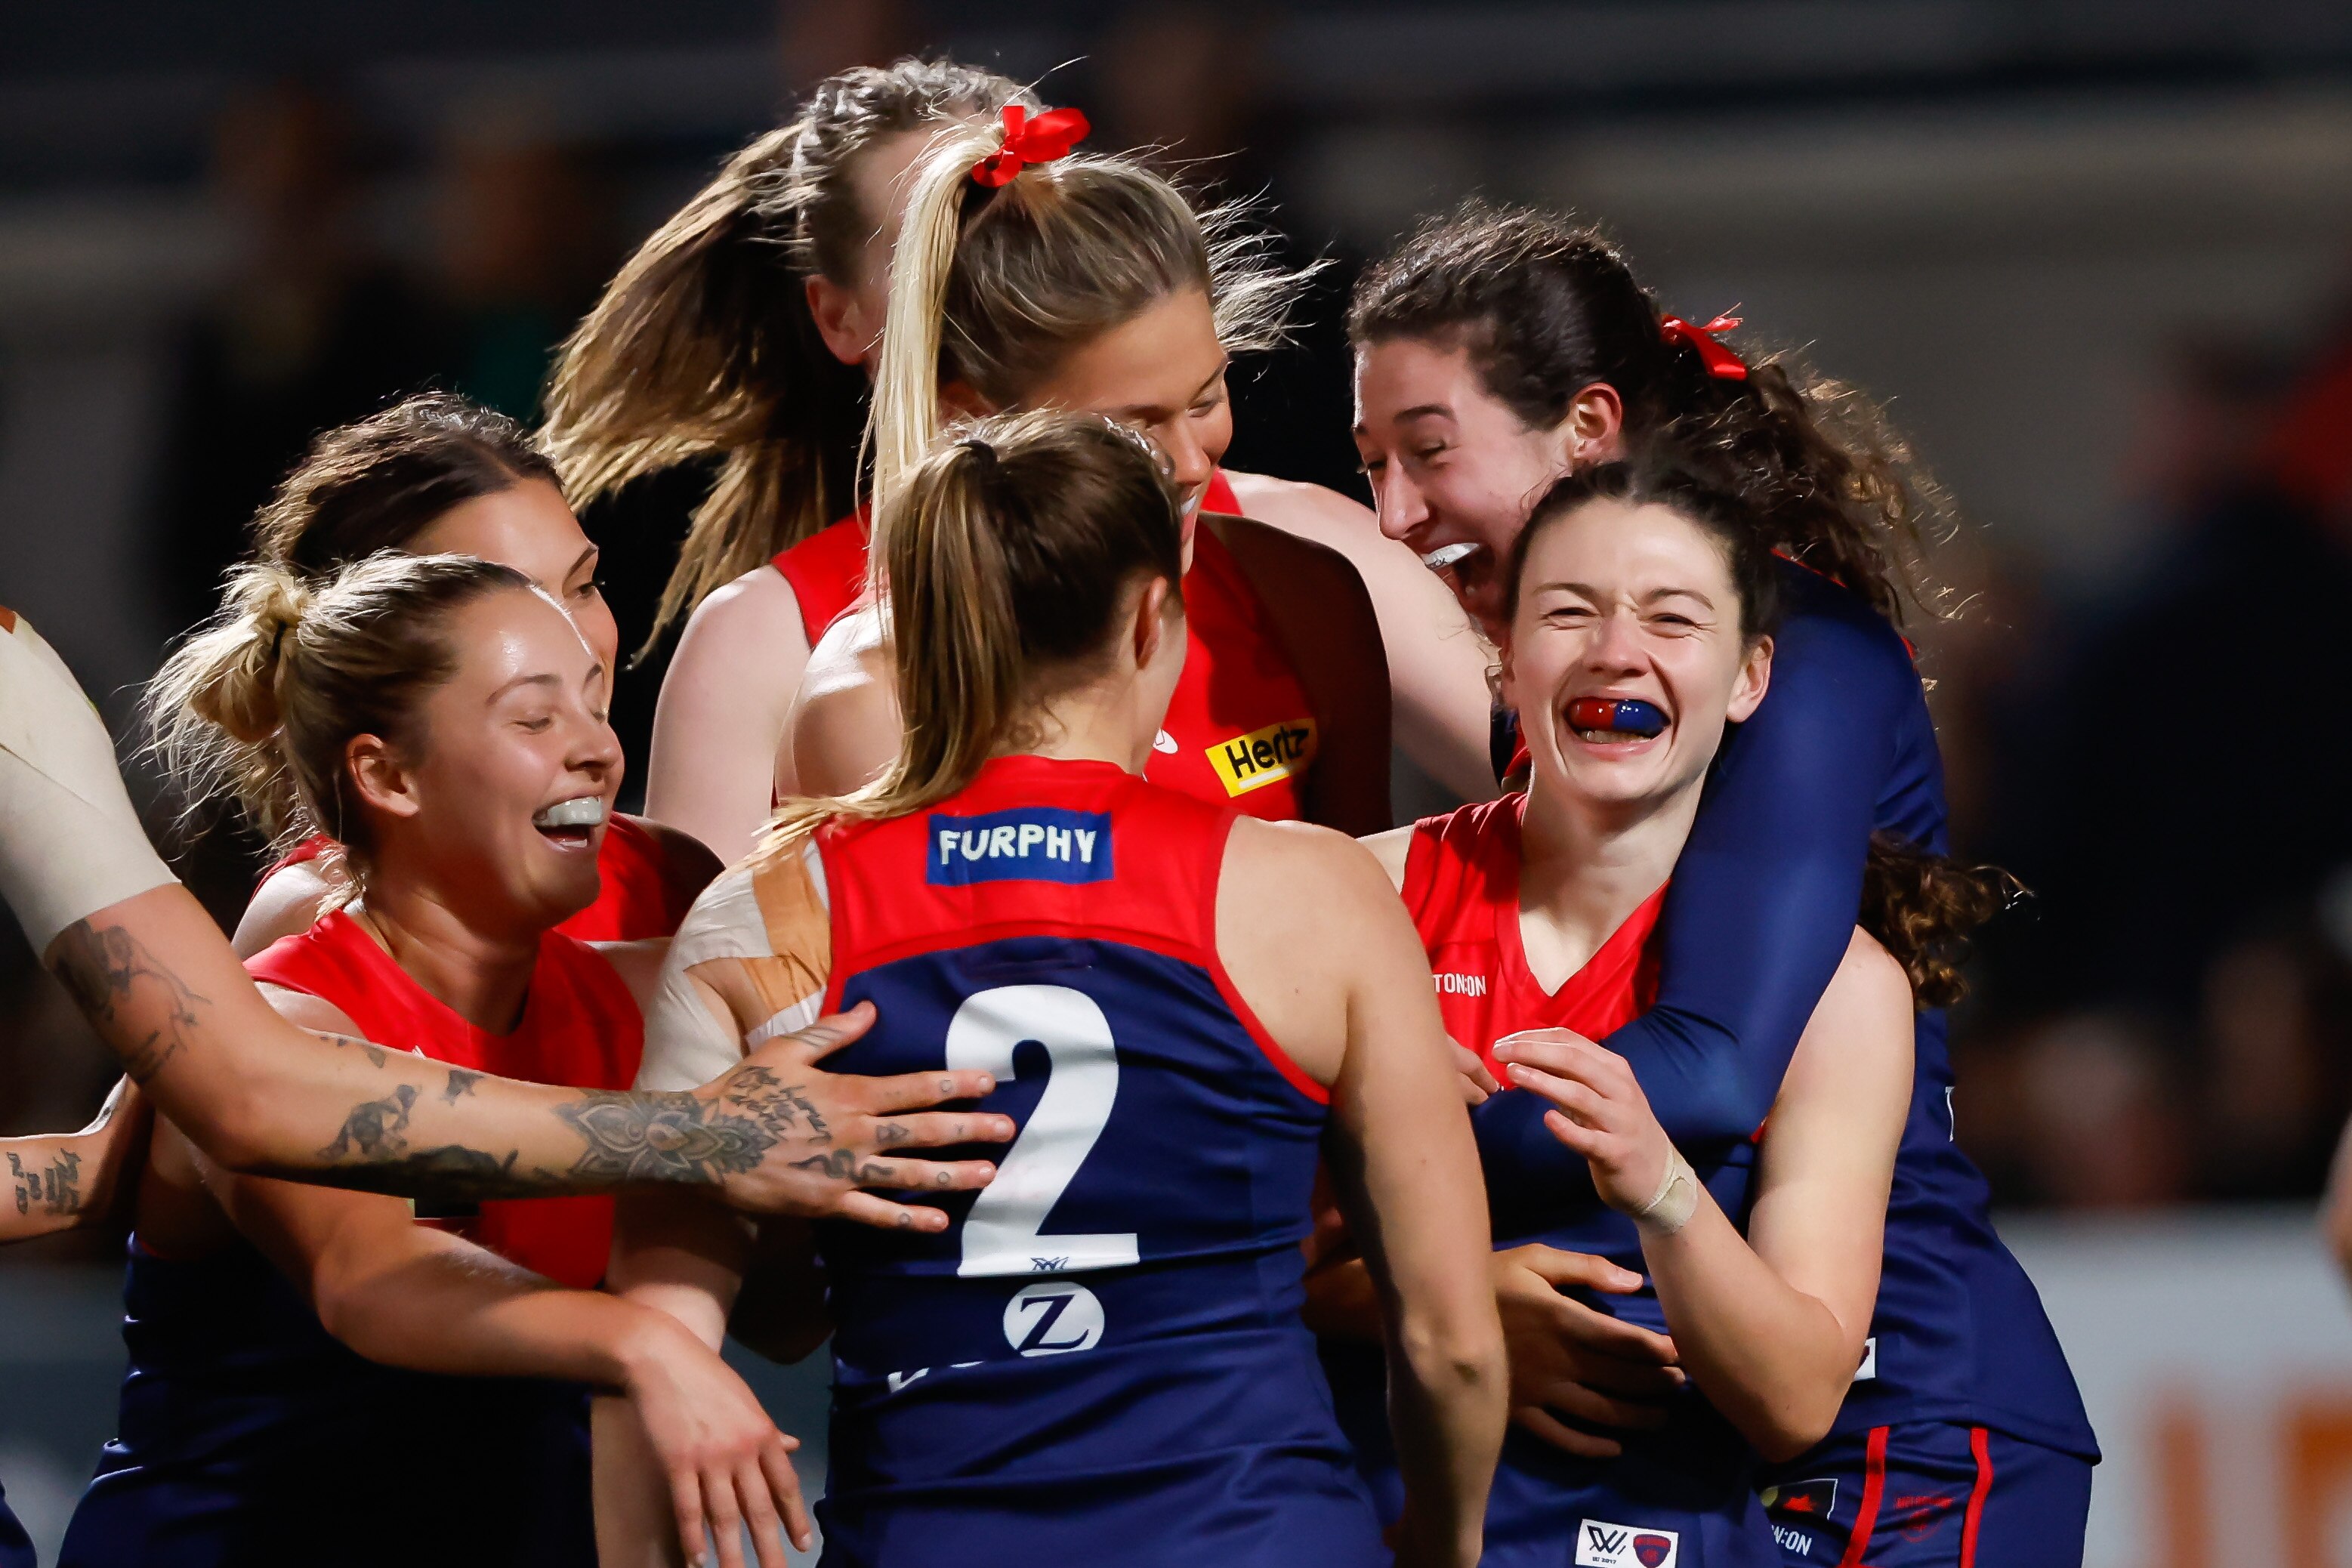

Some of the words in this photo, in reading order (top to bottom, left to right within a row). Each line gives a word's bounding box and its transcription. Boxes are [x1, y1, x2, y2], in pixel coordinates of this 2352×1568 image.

[1224, 725, 1310, 779] Hertz
[939, 824, 1097, 866] FURPHY
[1432, 973, 1486, 997] TON:ON
[945, 983, 1141, 1277] 2
[1019, 1294, 1090, 1352] Z
[1771, 1524, 1813, 1556] N:ON
